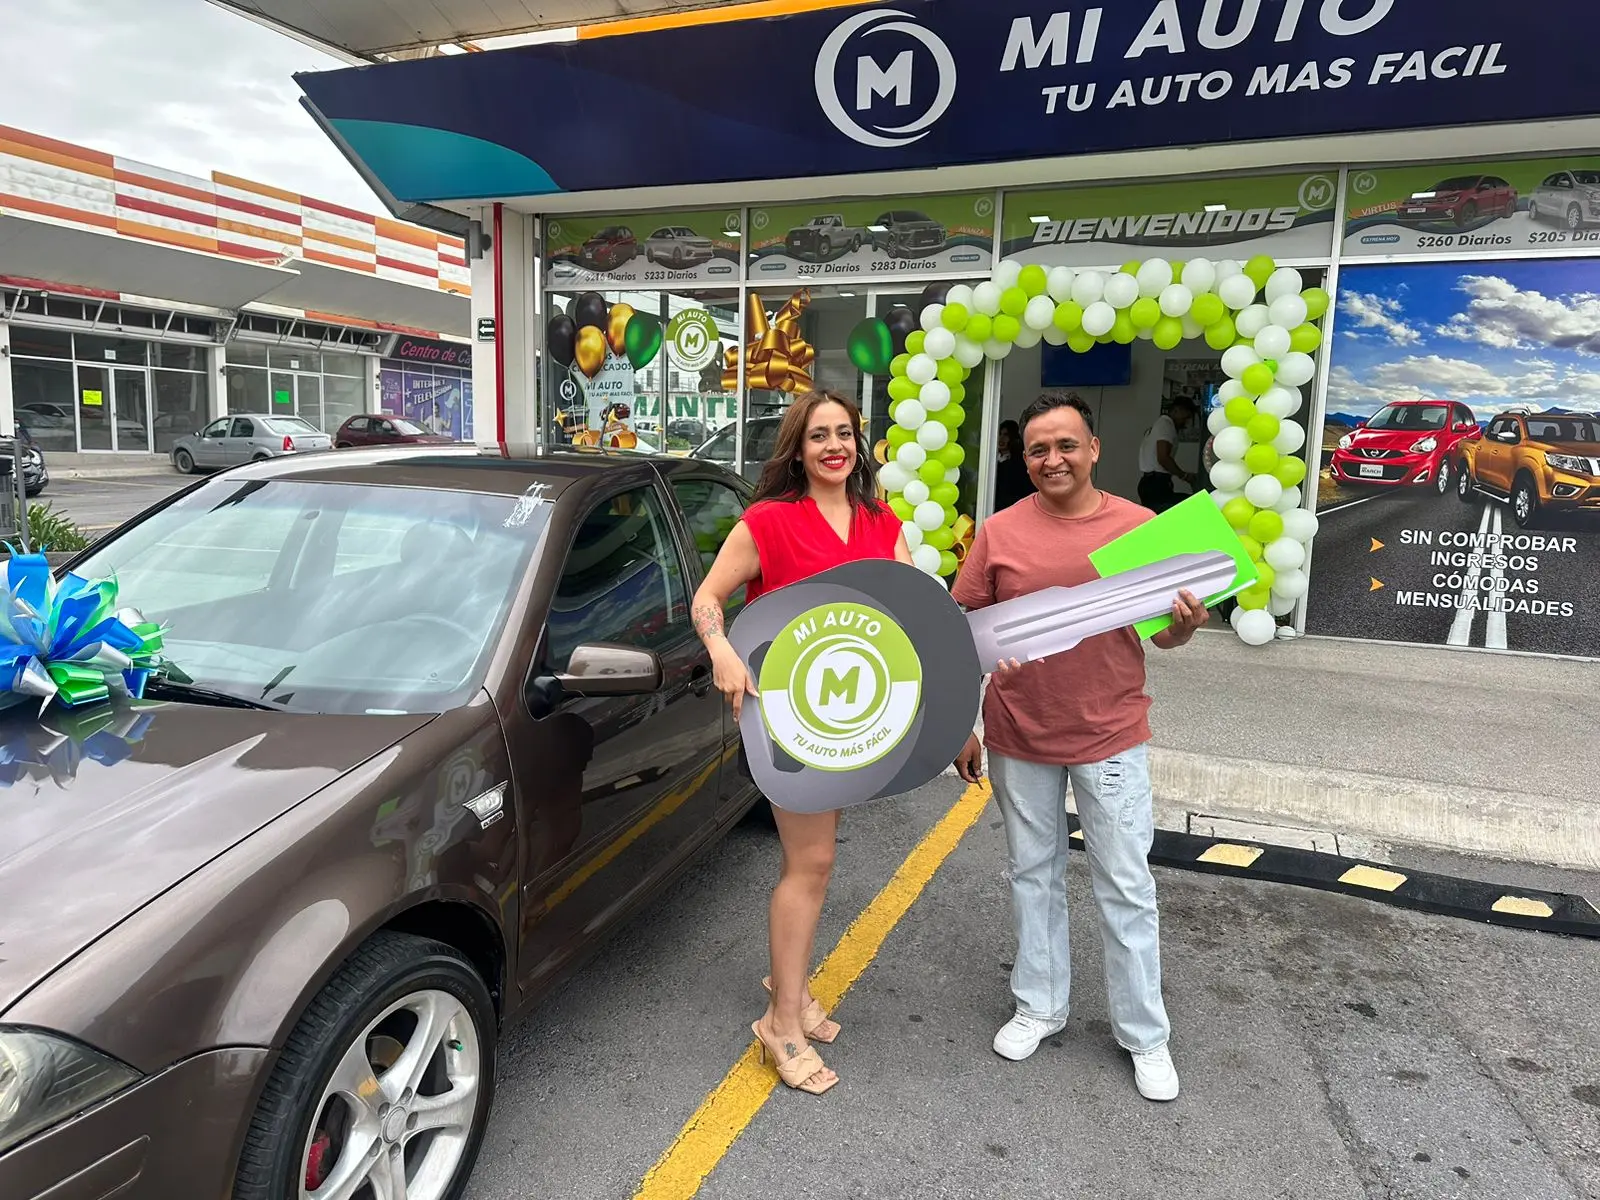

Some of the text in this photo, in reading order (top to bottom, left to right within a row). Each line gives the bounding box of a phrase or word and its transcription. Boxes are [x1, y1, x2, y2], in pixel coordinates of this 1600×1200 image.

[1000, 0, 1395, 72] MI AUTO
[856, 50, 914, 111] M
[1041, 42, 1507, 114] TU AUTO MAS FACIL
[1361, 201, 1397, 216] VIRTUS
[1032, 206, 1300, 243] BIENVENIDOS
[1417, 234, 1512, 248] $260 Diarios
[1528, 231, 1567, 244] $205
[607, 272, 637, 281] Diarios
[667, 270, 698, 280] Diarios
[797, 264, 822, 275] $357
[824, 263, 860, 274] Diarios
[870, 259, 937, 272] $283 Diarios
[687, 311, 707, 323] AUTO
[400, 341, 472, 366] Centro de Ca
[598, 381, 623, 390] AUTO
[1400, 529, 1577, 553] SIN COMPROBAR
[1430, 551, 1539, 572] INGRESOS
[1432, 572, 1539, 594] CÓMODAS
[1396, 591, 1574, 617] MENSUALIDADES
[792, 610, 882, 646] MI AUTO
[818, 665, 861, 706] M
[793, 726, 892, 758] TU AUTO MÁS FÁCIL
